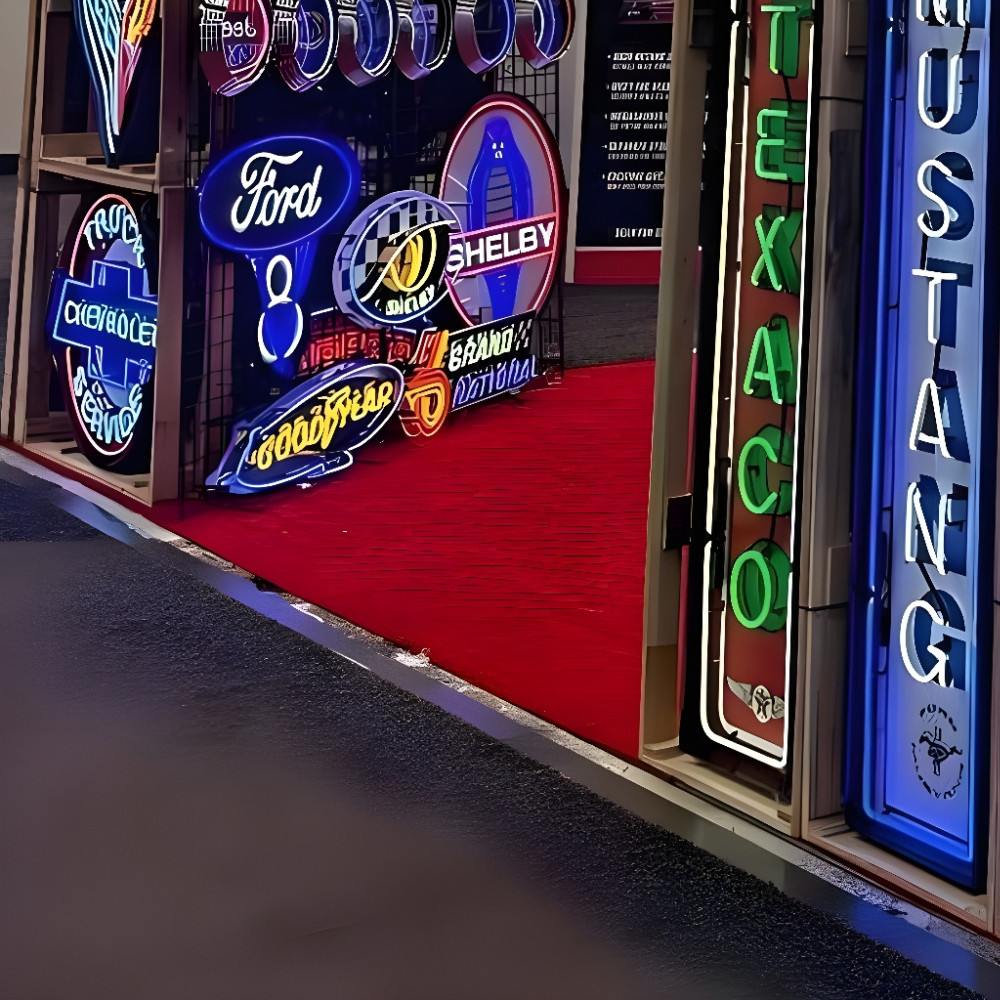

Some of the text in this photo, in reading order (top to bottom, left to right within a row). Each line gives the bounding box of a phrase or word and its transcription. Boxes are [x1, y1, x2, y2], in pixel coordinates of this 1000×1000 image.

[230, 149, 324, 233] Ford
[445, 221, 555, 273] SHELBY
[448, 324, 516, 373] GRAND
[246, 379, 394, 472] GOODYEAR
